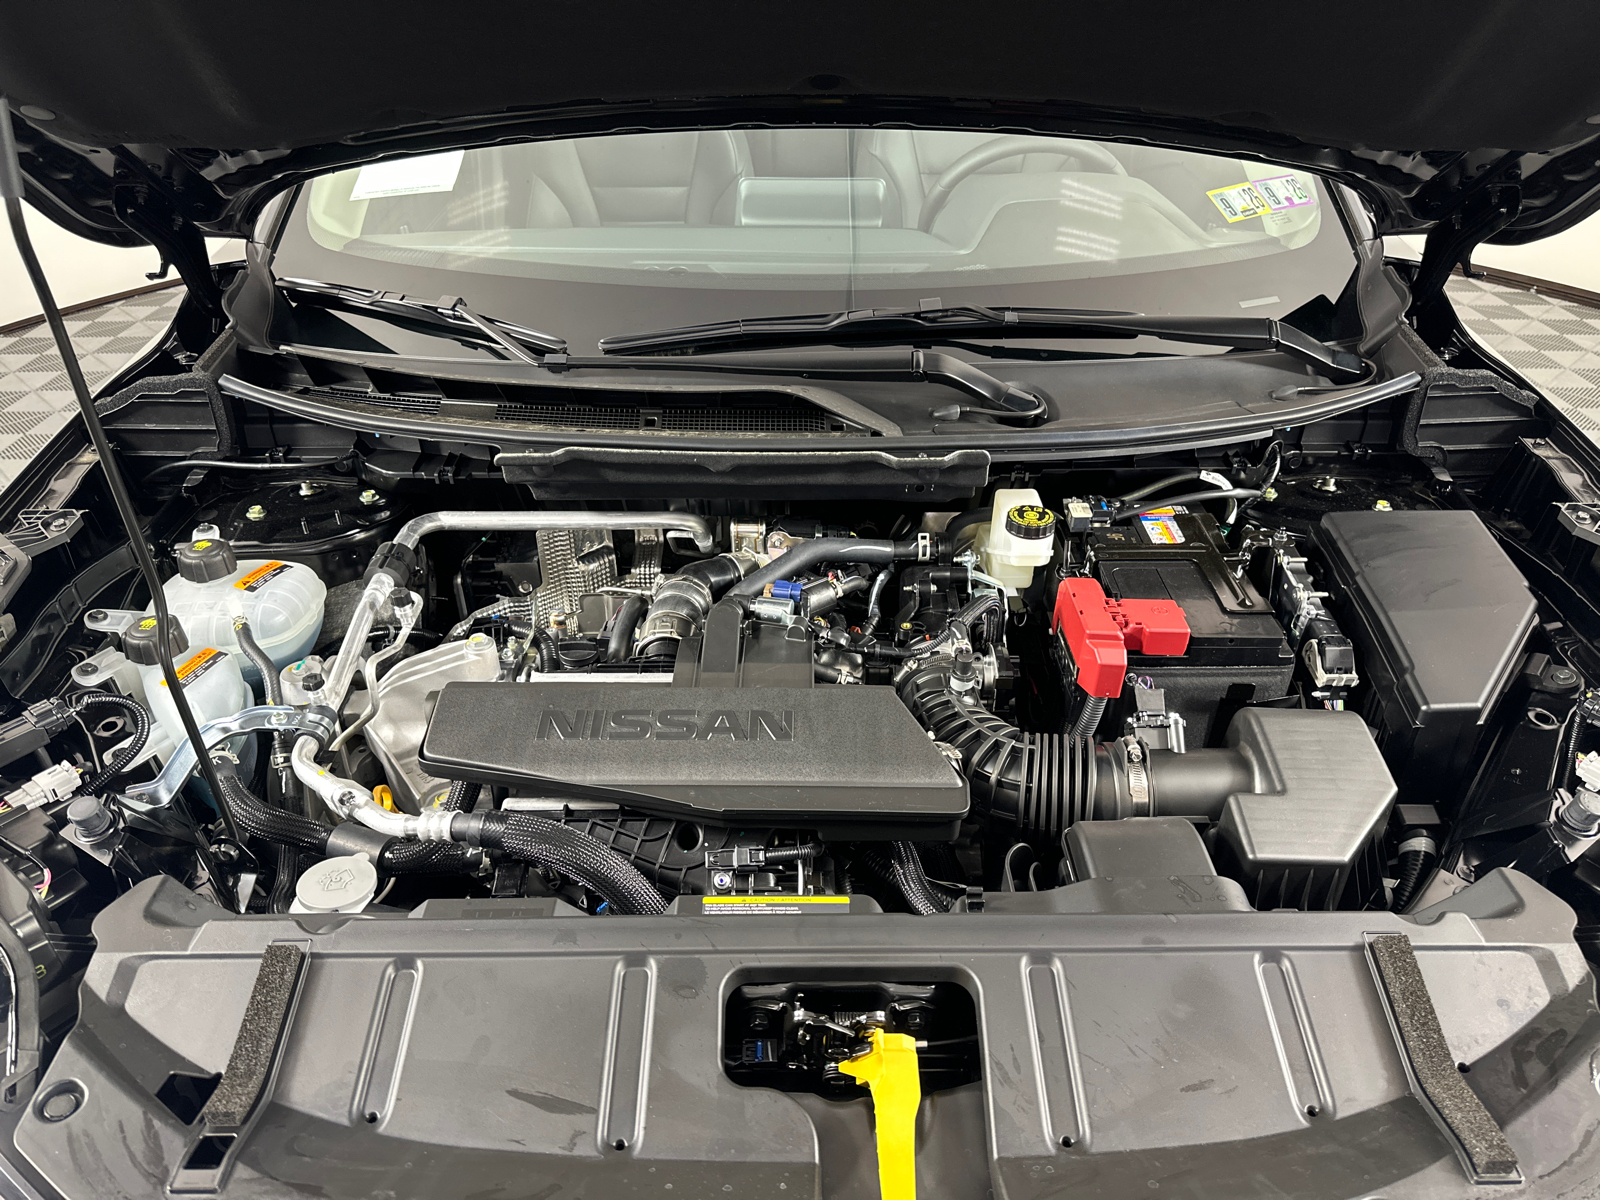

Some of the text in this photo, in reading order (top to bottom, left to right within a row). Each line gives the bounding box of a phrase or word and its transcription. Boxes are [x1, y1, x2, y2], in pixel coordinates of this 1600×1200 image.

[1219, 197, 1238, 217] 9
[1241, 187, 1266, 209] 26
[1264, 186, 1281, 205] 9
[534, 709, 794, 741] NISSAN
